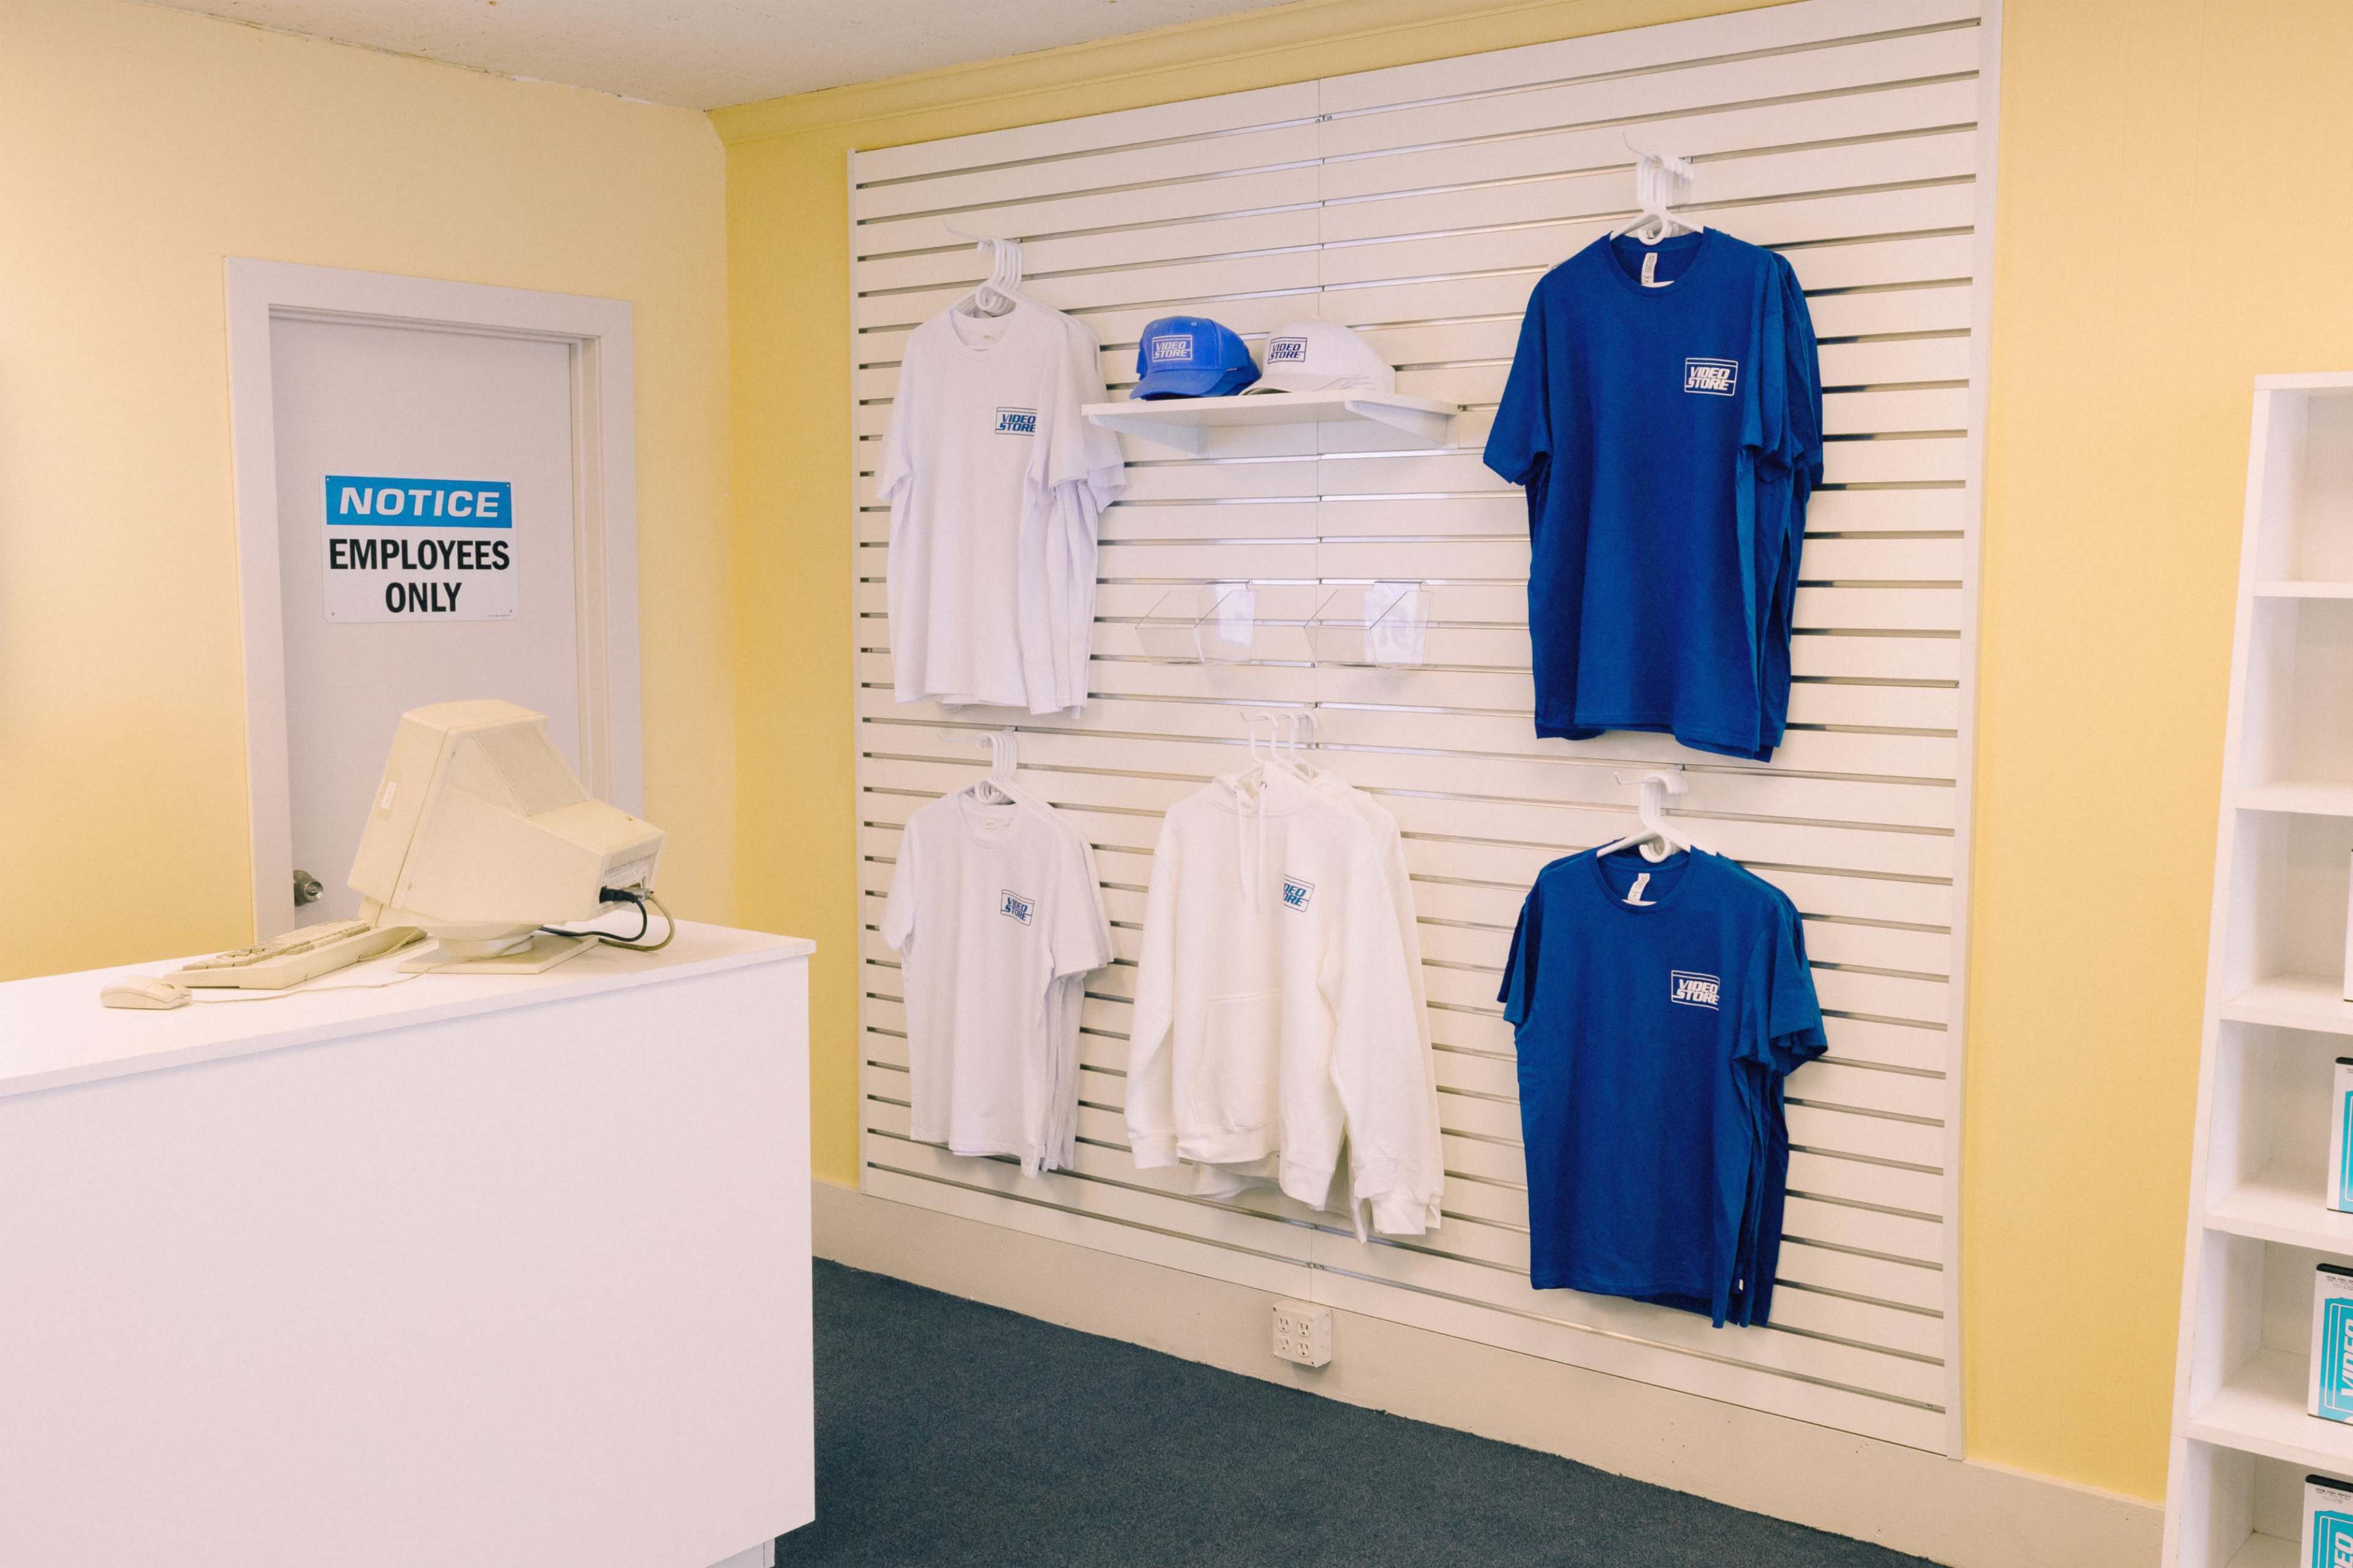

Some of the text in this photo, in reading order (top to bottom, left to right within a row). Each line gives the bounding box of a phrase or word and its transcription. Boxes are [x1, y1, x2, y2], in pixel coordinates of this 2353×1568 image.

[1156, 341, 1186, 350] VIDEO
[1272, 343, 1301, 352] VIDEO
[1153, 349, 1188, 358] STORE
[1270, 350, 1300, 360] STORE
[1690, 366, 1730, 379] VIDEO
[1687, 377, 1729, 391] STORE
[1002, 414, 1036, 424] VIDEO
[999, 422, 1036, 432] STORE
[339, 487, 500, 518] NOTICE
[329, 538, 510, 570] EMPLOYEES
[385, 581, 462, 613] ONLY
[1284, 883, 1306, 897] DEO
[1007, 896, 1028, 912] VIDEO
[1284, 892, 1303, 906] ORE
[1005, 904, 1027, 921] STORE
[1679, 979, 1719, 994] VIDEO
[1677, 988, 1719, 1005] STORE
